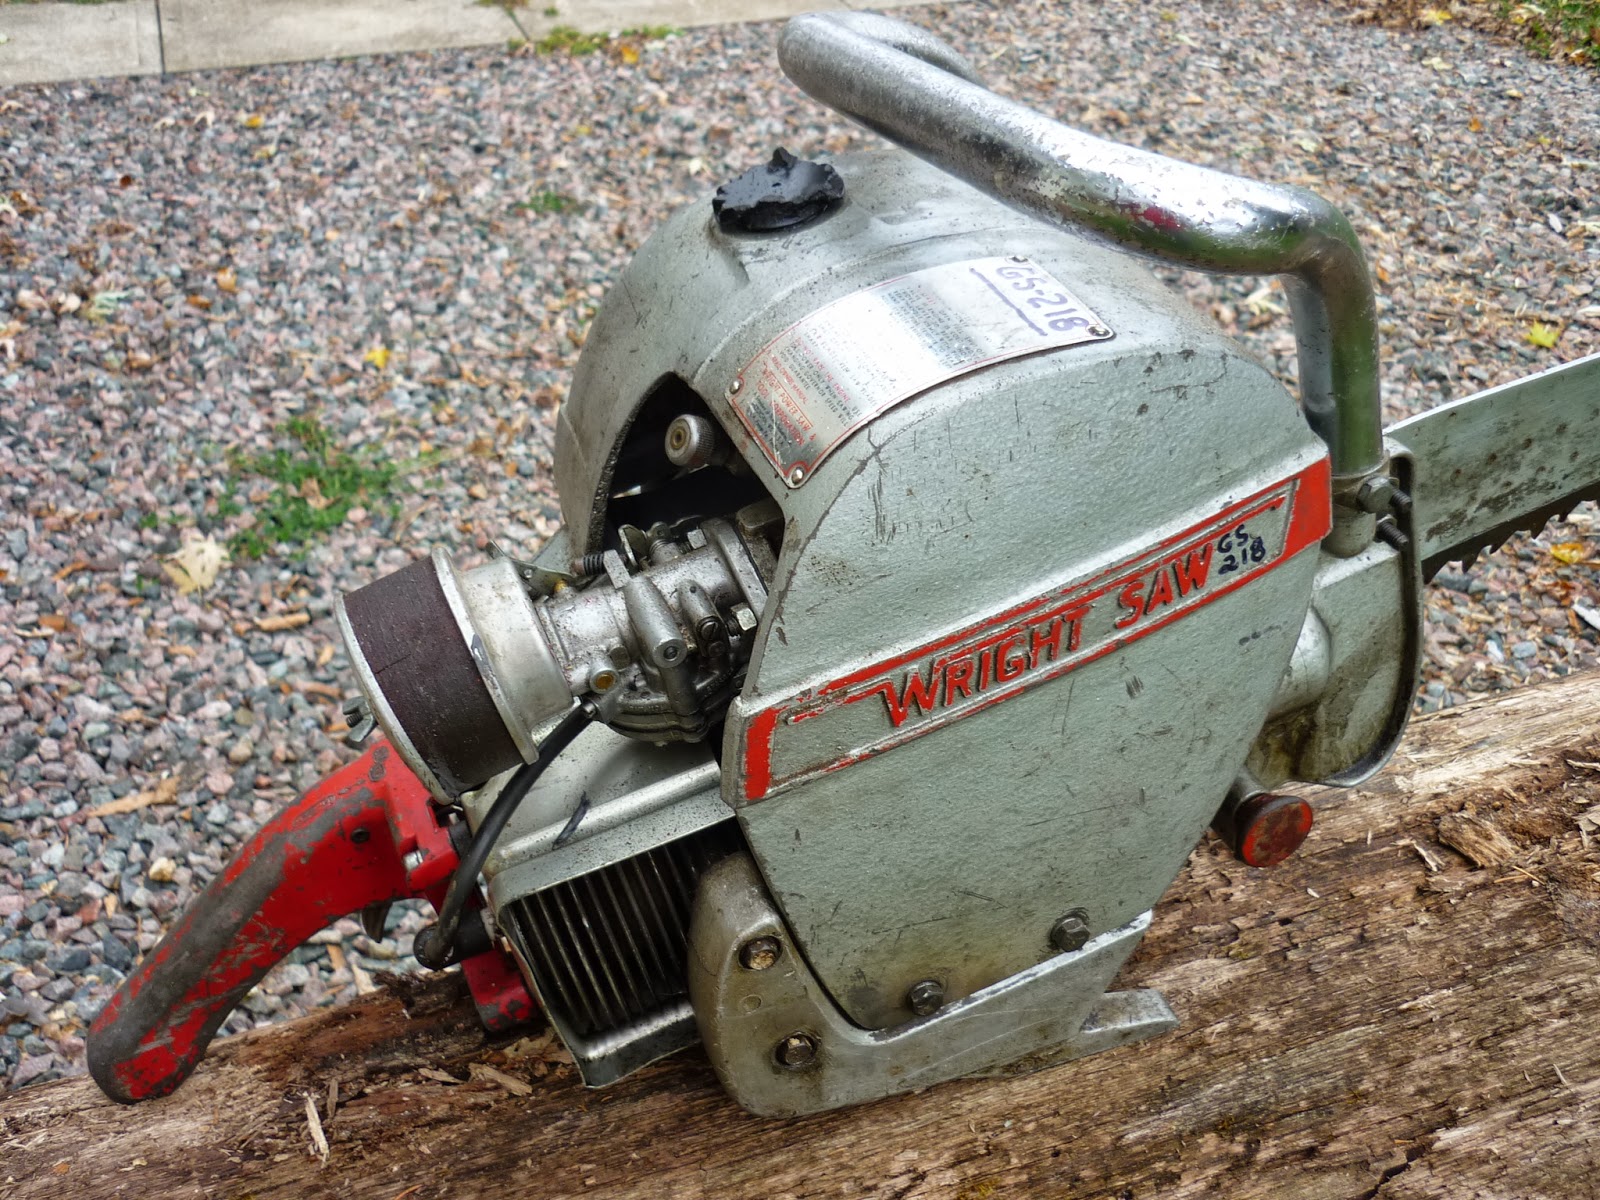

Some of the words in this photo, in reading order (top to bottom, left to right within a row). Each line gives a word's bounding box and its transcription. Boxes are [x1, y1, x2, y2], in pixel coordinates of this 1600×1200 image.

[777, 391, 798, 416] POWER
[794, 415, 811, 433] SAW
[1217, 524, 1248, 553] GS
[1218, 536, 1265, 574] 218
[879, 606, 1090, 727] WRIGHT
[1116, 543, 1214, 629] SAW
